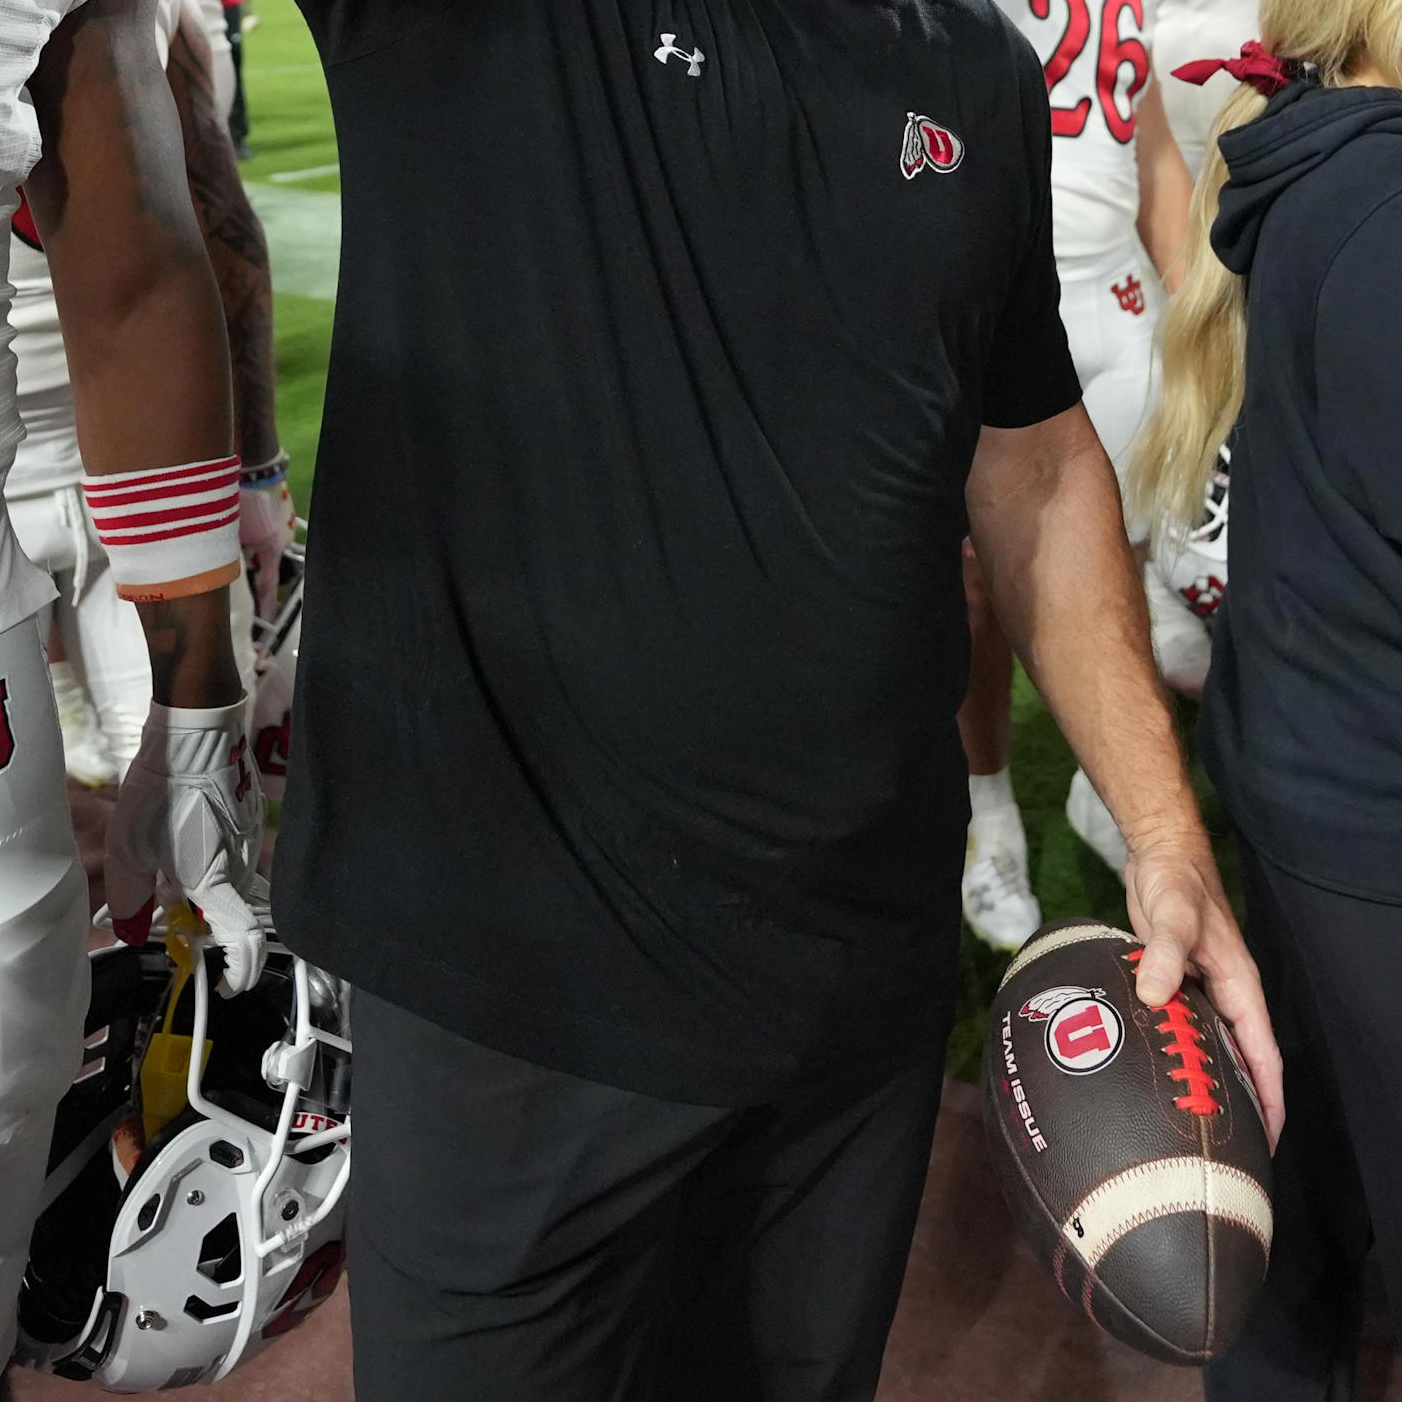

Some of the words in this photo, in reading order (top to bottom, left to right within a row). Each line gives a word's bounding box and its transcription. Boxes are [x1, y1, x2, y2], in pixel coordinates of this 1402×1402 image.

[922, 125, 954, 165] U
[1054, 1004, 1112, 1060] U
[1001, 1010, 1018, 1076] TEAM
[1010, 1078, 1048, 1153] ISSUE
